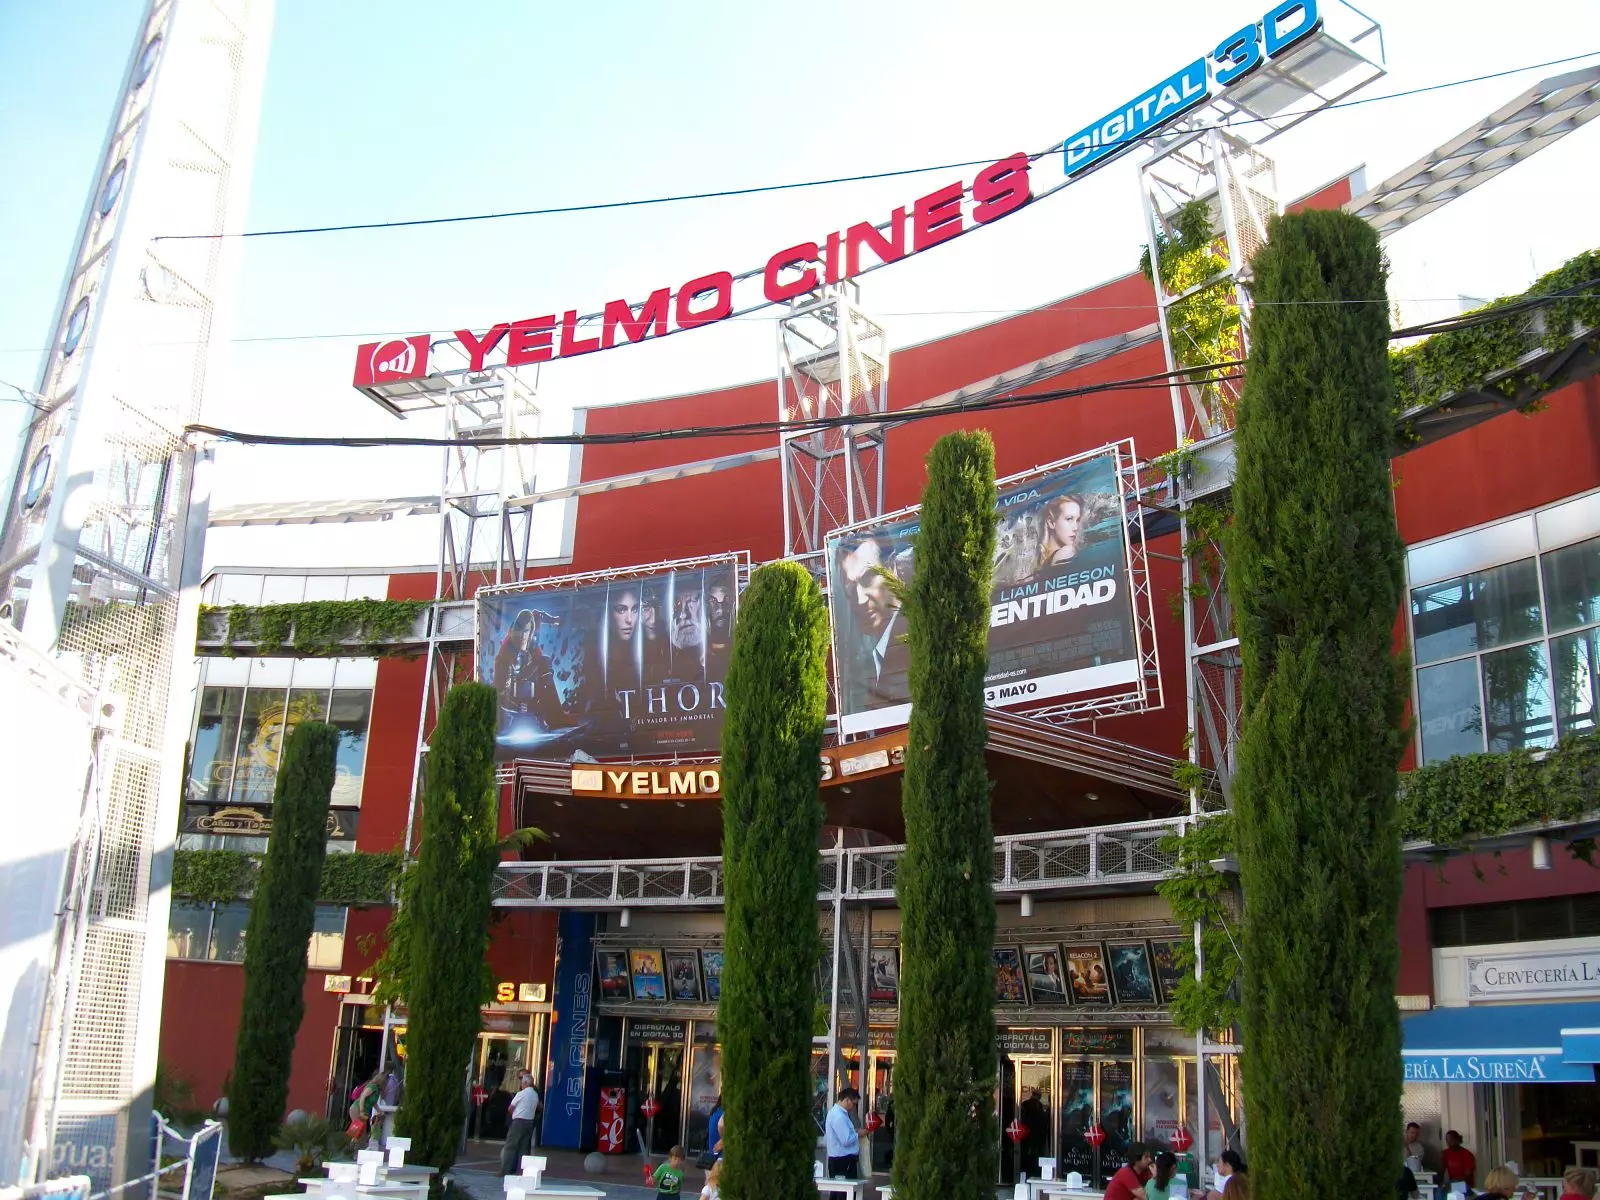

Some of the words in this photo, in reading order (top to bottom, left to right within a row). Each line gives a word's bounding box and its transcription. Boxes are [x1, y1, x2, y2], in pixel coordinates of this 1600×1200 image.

[1067, 73, 1203, 166] DIGITAL
[1214, 0, 1319, 86] 3D
[454, 270, 732, 373] YELMO
[763, 151, 1031, 304] CINES
[1000, 583, 1039, 602] LIAM
[1044, 564, 1116, 592] NEESON
[991, 578, 1117, 627] ENTIDAD
[618, 681, 727, 719] THOR
[999, 682, 1038, 699] MAYO
[607, 770, 720, 795] YELMO
[1484, 965, 1580, 986] CERVECERÍA
[569, 973, 590, 1067] CINES
[1404, 1060, 1439, 1079] ERÍA
[1441, 1057, 1465, 1079] LA
[1467, 1056, 1547, 1080] SUREÑA
[566, 1077, 583, 1116] 15
